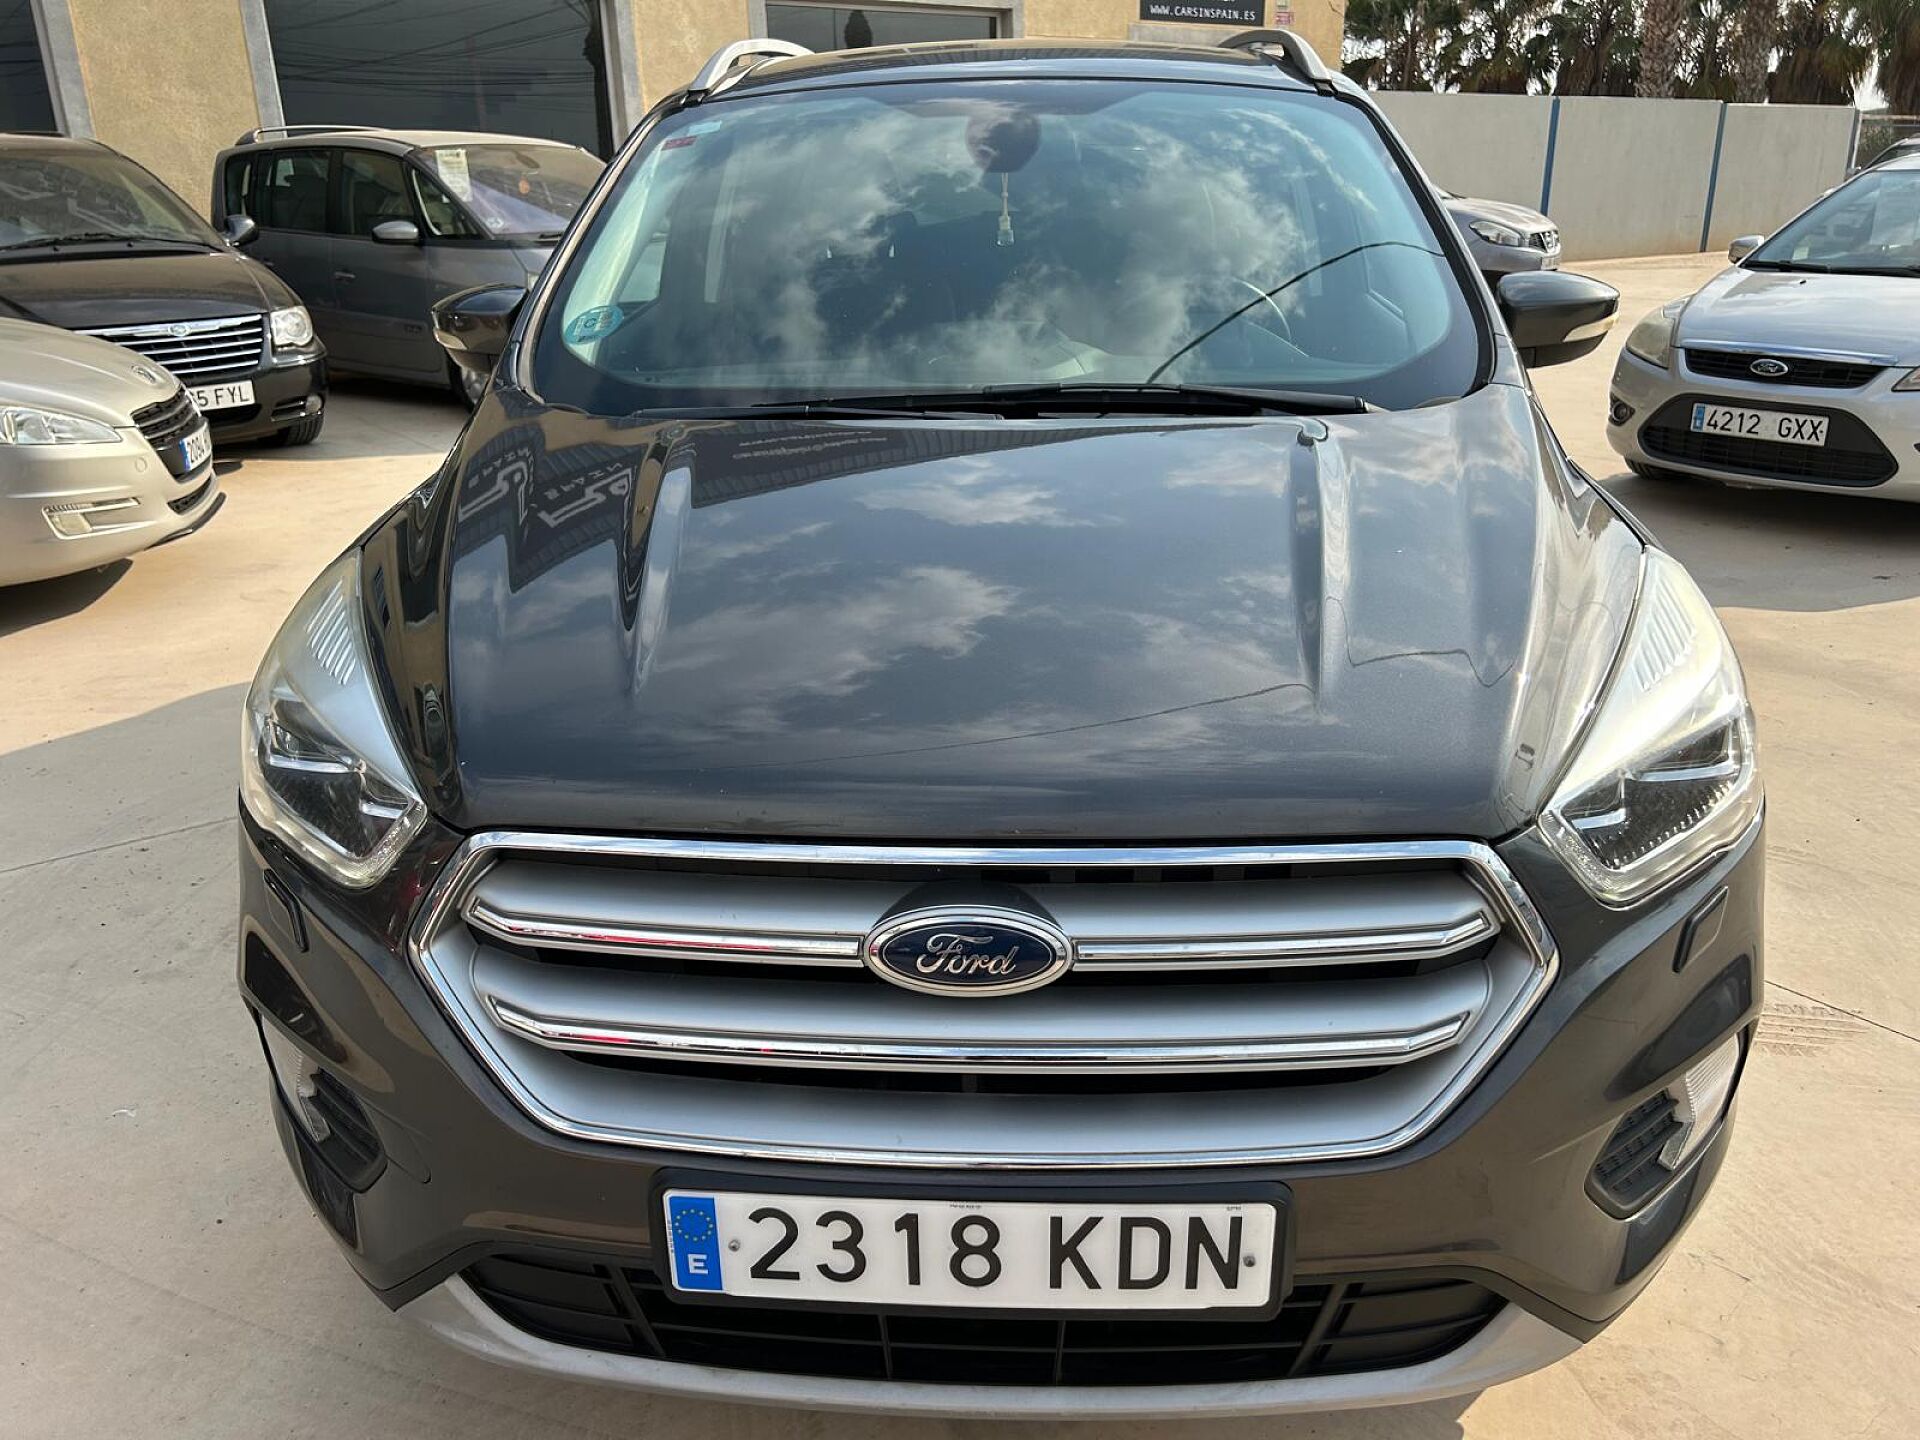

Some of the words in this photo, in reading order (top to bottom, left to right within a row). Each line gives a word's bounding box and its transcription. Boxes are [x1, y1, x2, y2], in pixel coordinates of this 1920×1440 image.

[1150, 4, 1256, 21] WWW.CARSINSPAIN.ES
[214, 385, 250, 406] FYL
[1707, 410, 1761, 435] 4212
[1778, 417, 1823, 442] GXX
[916, 933, 1020, 976] Ford
[748, 1207, 1002, 1287] 2318
[1049, 1216, 1243, 1289] KDN
[687, 1253, 709, 1275] E
